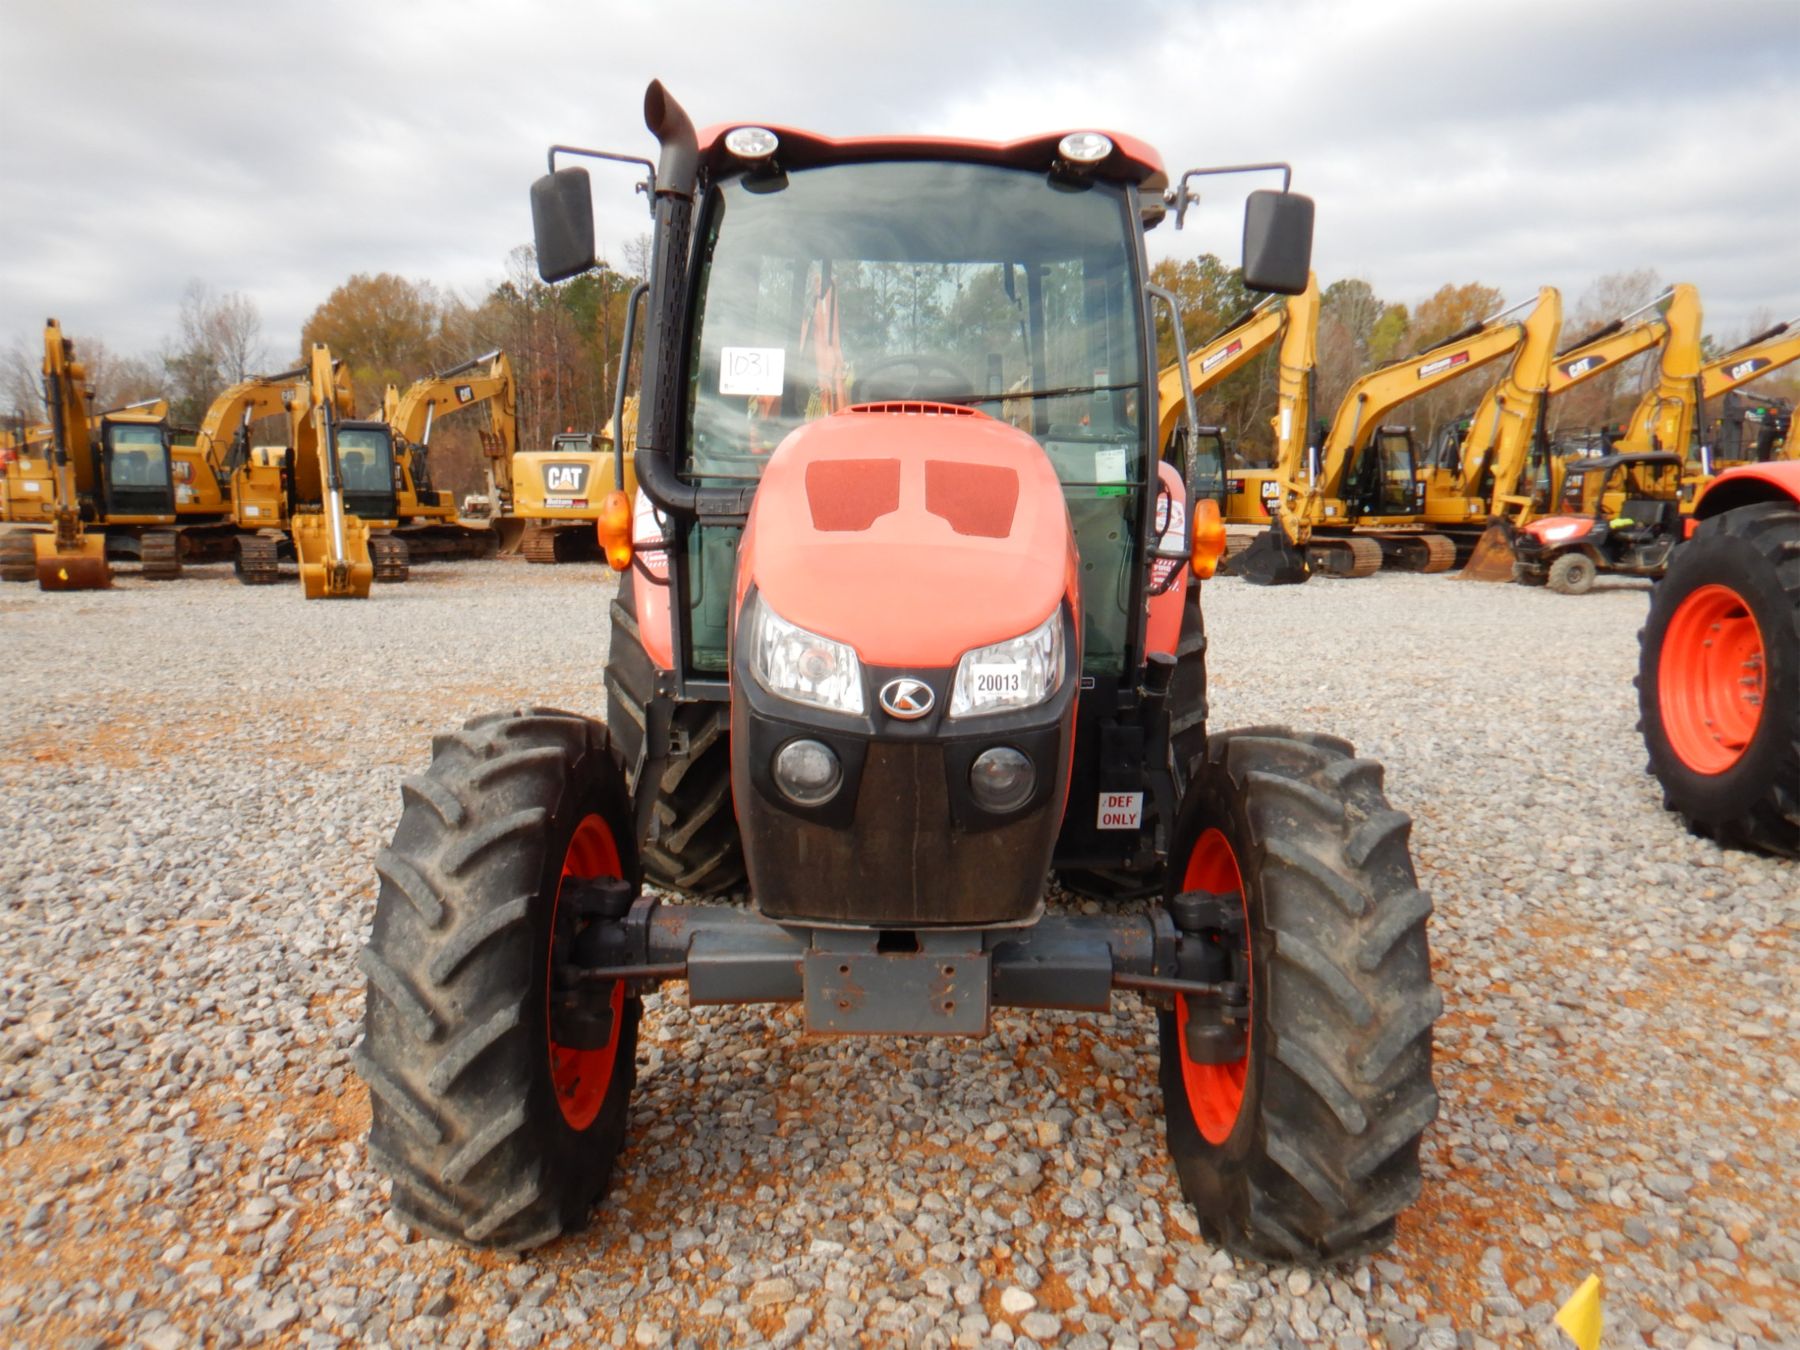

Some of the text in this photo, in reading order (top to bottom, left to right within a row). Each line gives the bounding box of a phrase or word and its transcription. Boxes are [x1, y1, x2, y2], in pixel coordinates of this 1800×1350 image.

[729, 352, 770, 377] 1031
[1568, 358, 1589, 378] CAT
[1731, 360, 1754, 380] CAT
[548, 467, 582, 490] CAT
[977, 674, 1019, 691] 20013
[1108, 795, 1134, 808] DEF
[1102, 813, 1137, 825] ONLY
